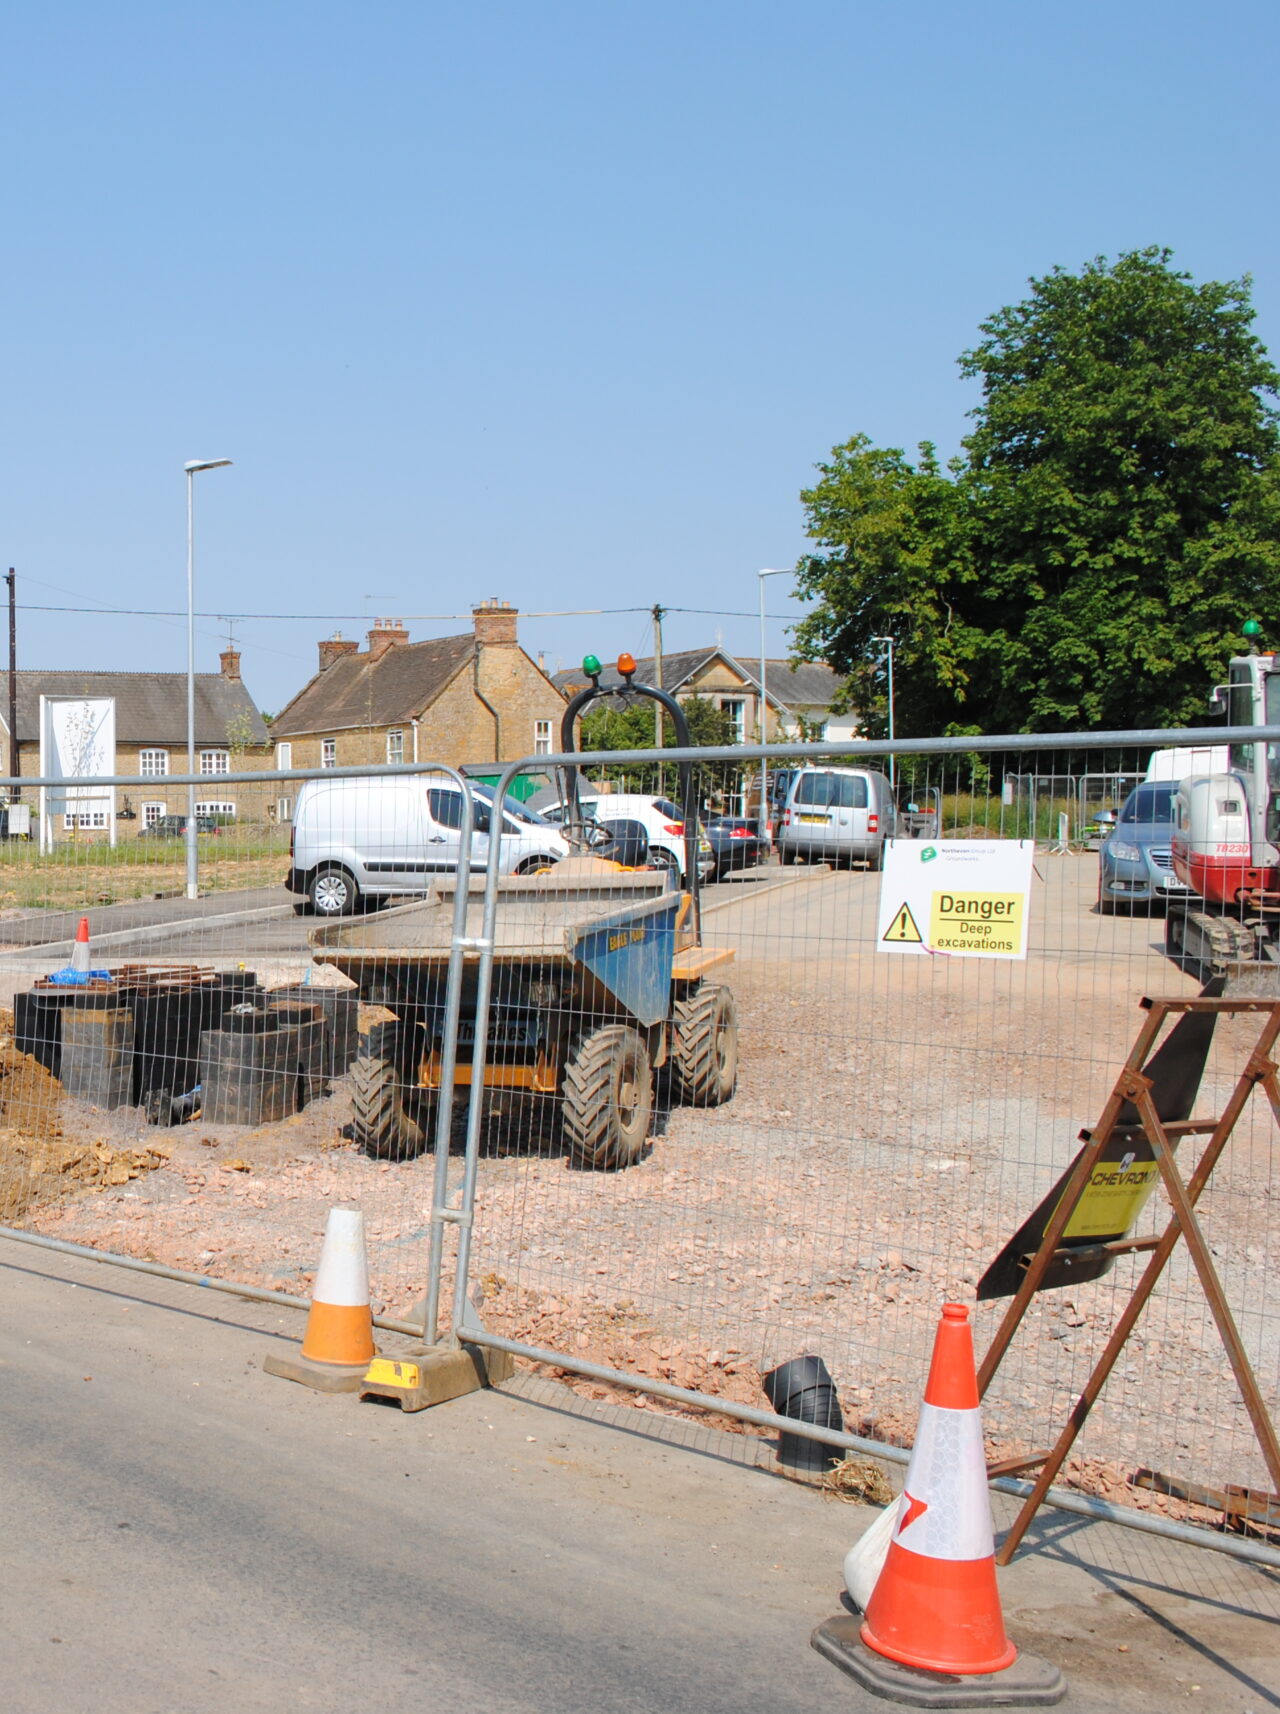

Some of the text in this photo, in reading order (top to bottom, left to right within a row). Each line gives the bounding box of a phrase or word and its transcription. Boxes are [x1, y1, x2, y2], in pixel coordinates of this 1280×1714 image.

[940, 895, 1015, 919] Danger
[960, 922, 992, 936] Deep
[938, 938, 1013, 950] excavations
[456, 1022, 527, 1042] Thaites
